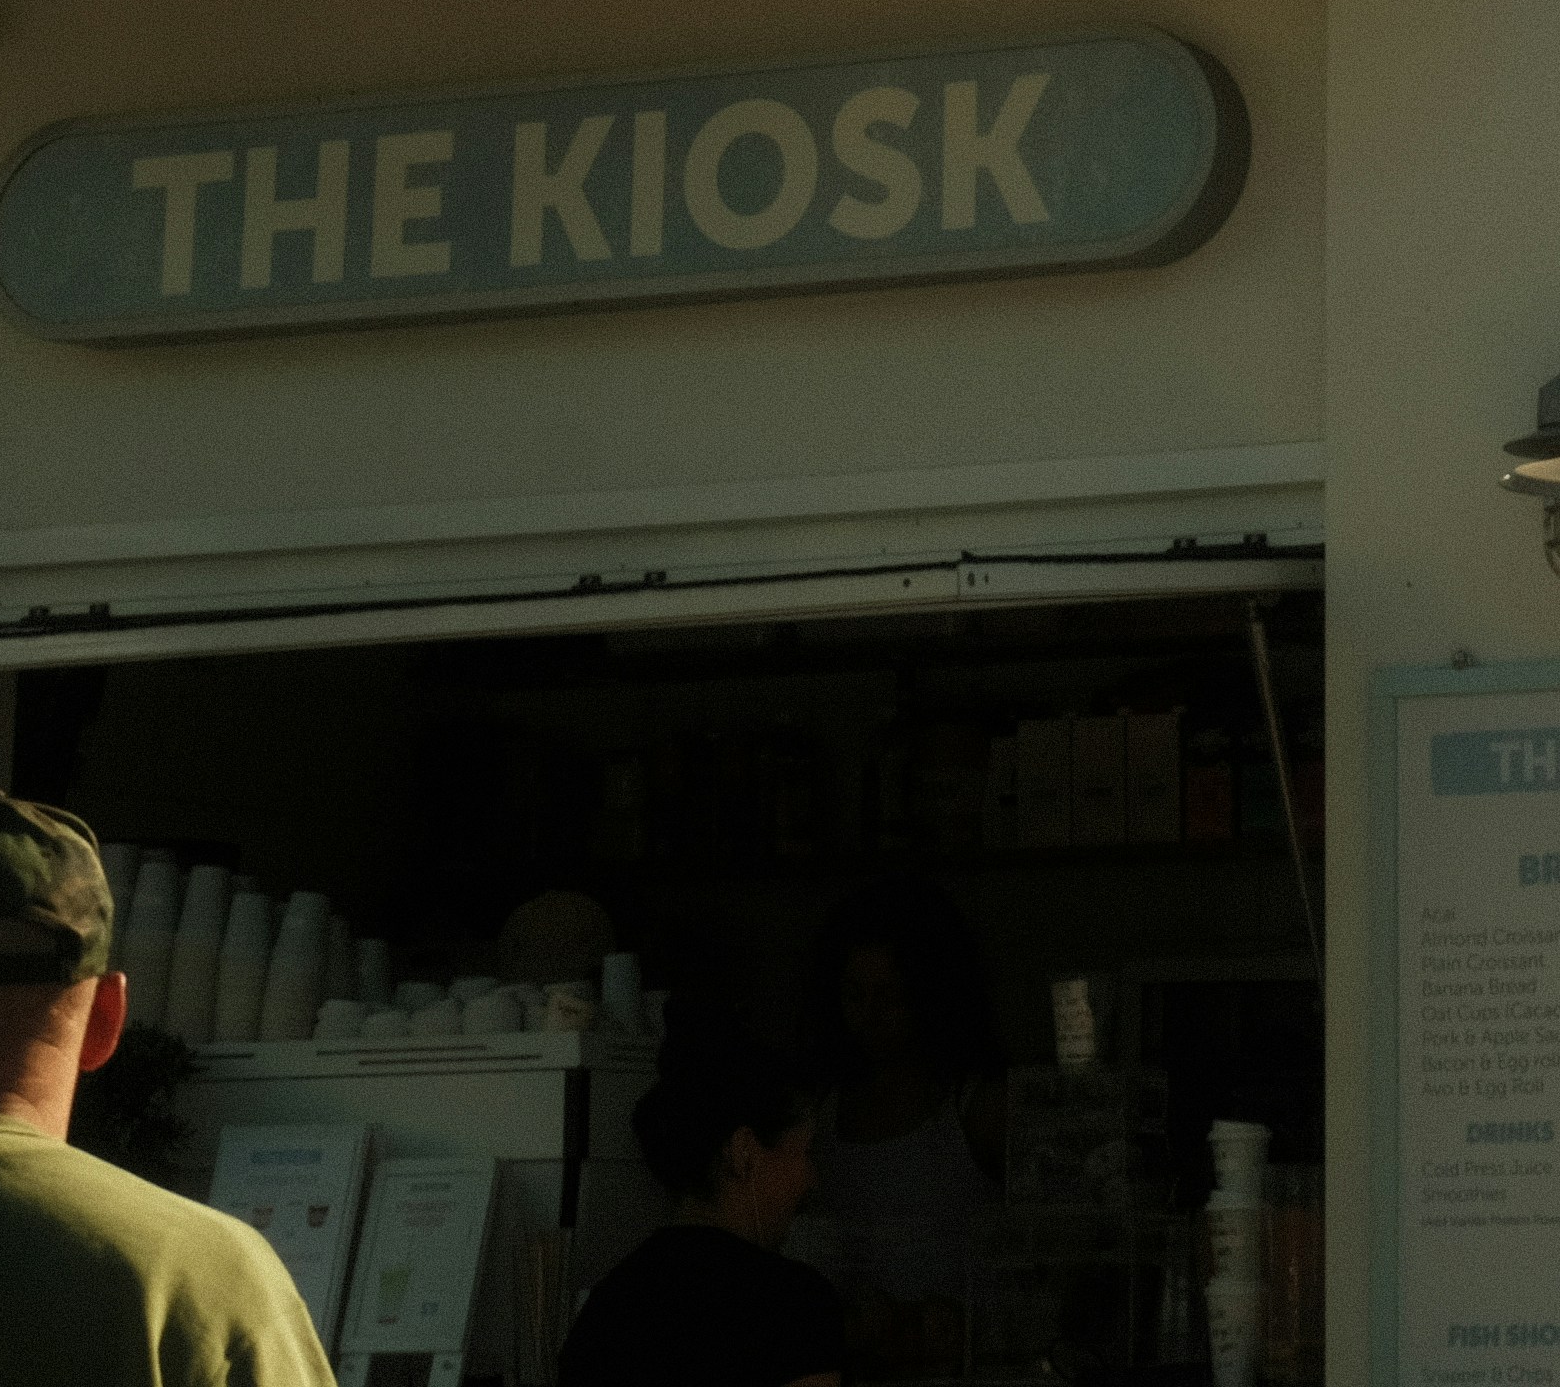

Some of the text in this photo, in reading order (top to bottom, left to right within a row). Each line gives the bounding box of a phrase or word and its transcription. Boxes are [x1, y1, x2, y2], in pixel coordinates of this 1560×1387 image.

[130, 72, 1052, 297] THE KIOSK
[1420, 929, 1488, 948] Almond
[1421, 952, 1545, 973] Plain Croissant
[1421, 977, 1538, 998] Banana Bread
[1421, 1005, 1452, 1022] Oat
[1456, 1003, 1500, 1024] Cups
[1421, 1028, 1460, 1047] Pork
[1481, 1027, 1530, 1049] Apple
[1421, 1054, 1476, 1074] Bacon
[1497, 1052, 1530, 1074] Egg
[1474, 1079, 1508, 1101] Egg
[1466, 1120, 1555, 1144] DRINKS
[1421, 1157, 1554, 1179] Cold Press Juice
[1421, 1186, 1508, 1204] Smoothies
[1448, 1324, 1501, 1348] FISH
